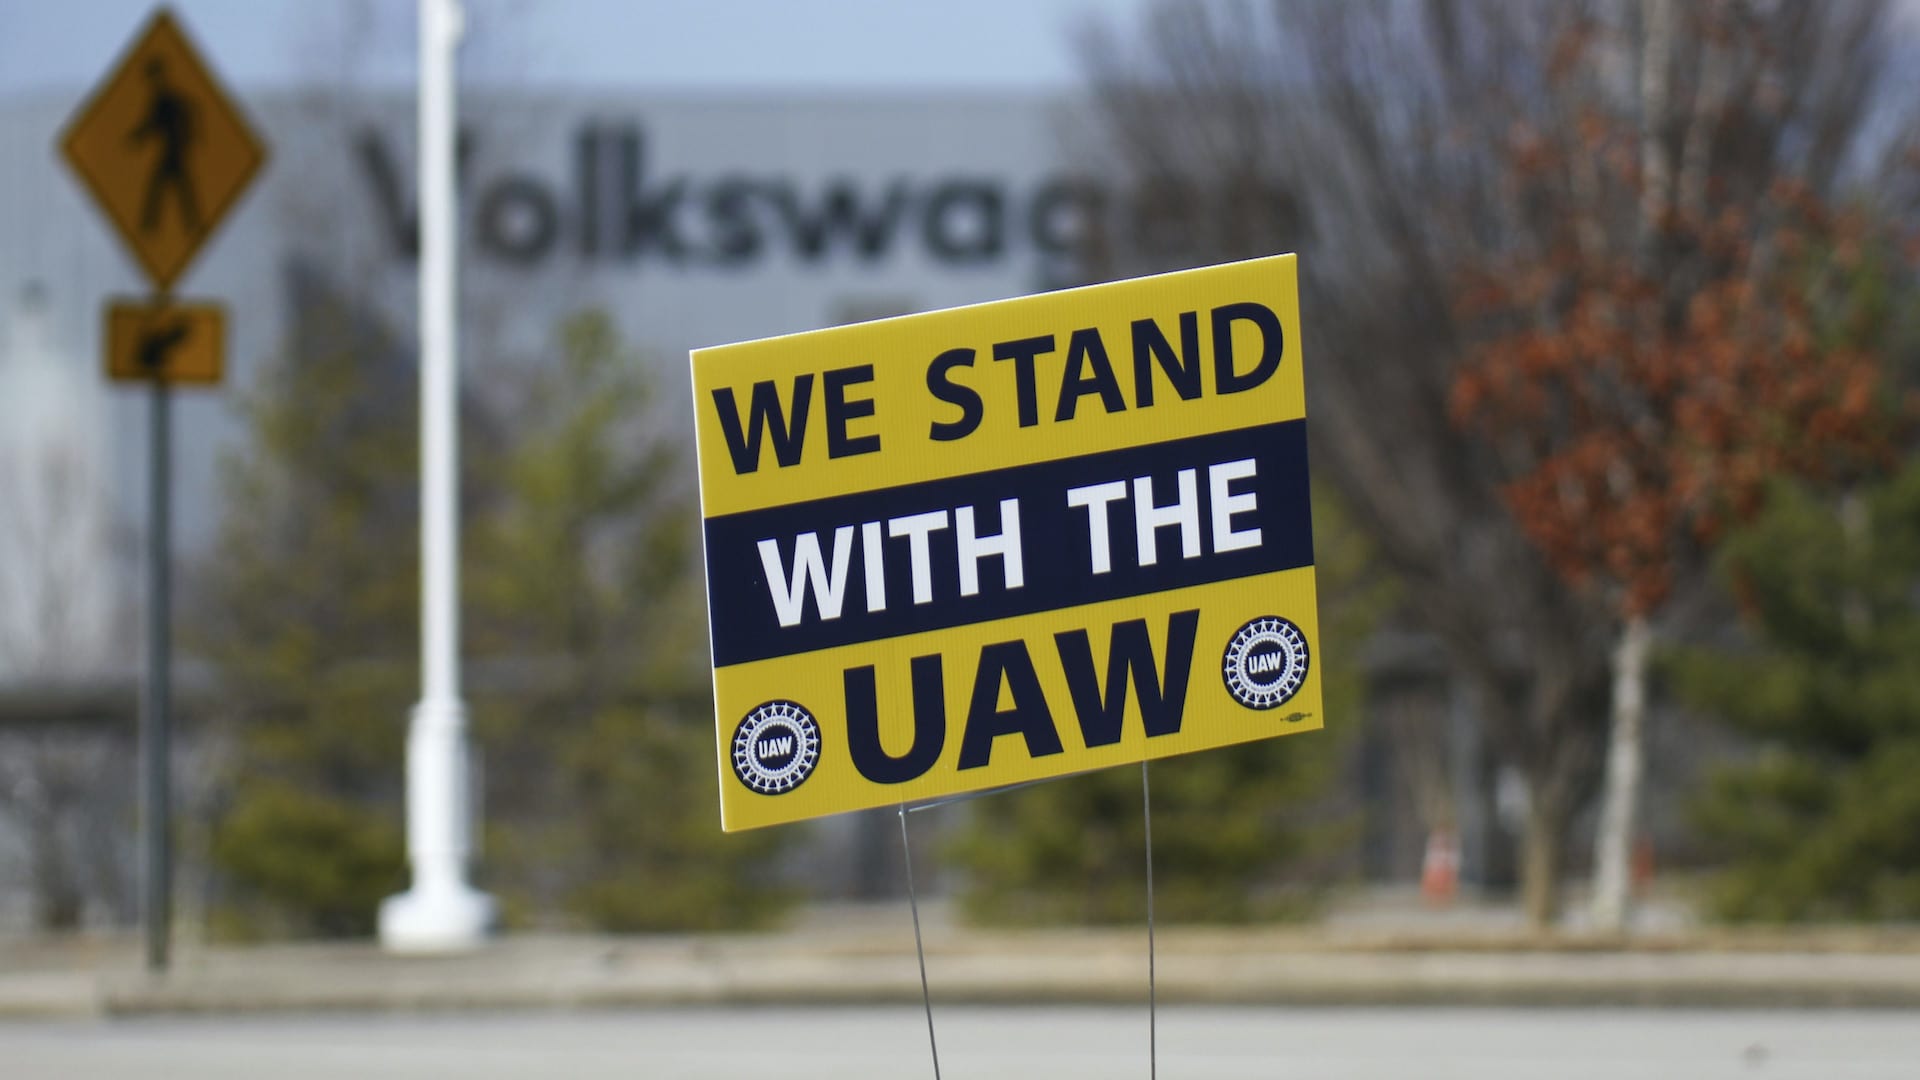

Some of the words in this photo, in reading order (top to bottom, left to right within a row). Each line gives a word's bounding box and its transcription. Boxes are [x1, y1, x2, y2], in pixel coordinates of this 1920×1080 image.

[354, 118, 1305, 284] Volkswag
[712, 365, 881, 474] WE
[927, 302, 1284, 441] STAND
[757, 498, 1024, 627] WITH
[1067, 458, 1262, 574] THE
[843, 609, 1200, 784] UAW
[1248, 652, 1282, 674] UAW
[758, 736, 793, 759] UAW
